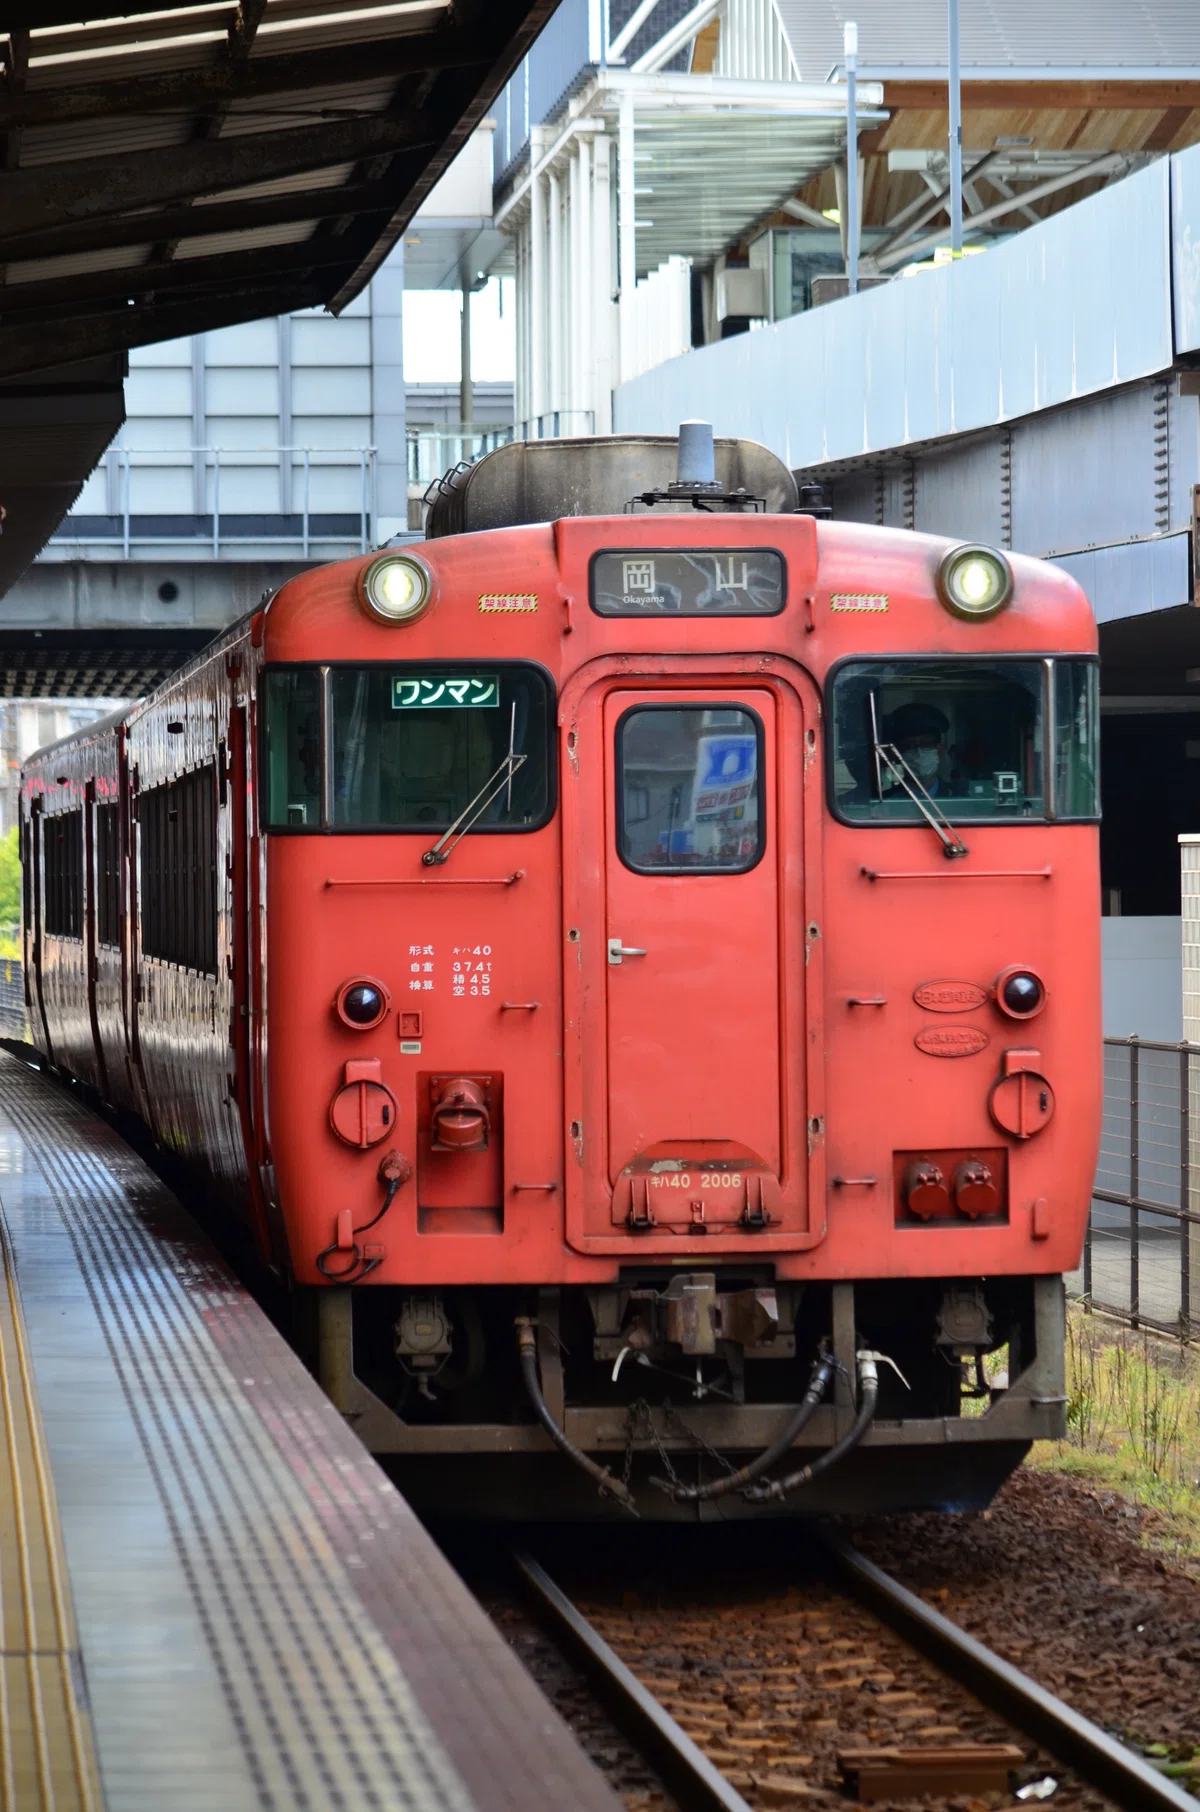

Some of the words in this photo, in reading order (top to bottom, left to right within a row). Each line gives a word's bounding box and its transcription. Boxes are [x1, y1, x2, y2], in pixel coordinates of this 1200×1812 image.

[623, 557, 748, 594] 岡山
[484, 598, 532, 609] 架線注意
[623, 595, 665, 604] Okayama
[836, 598, 883, 609] 架線注意
[396, 679, 495, 705] ワンマン
[409, 945, 435, 956] 形式
[410, 962, 434, 973] 自重
[470, 974, 491, 985] 4.5
[453, 986, 465, 996] 空
[470, 986, 491, 996] 3.5
[651, 1174, 691, 1188] キハ40
[701, 1174, 742, 1188] 2006
